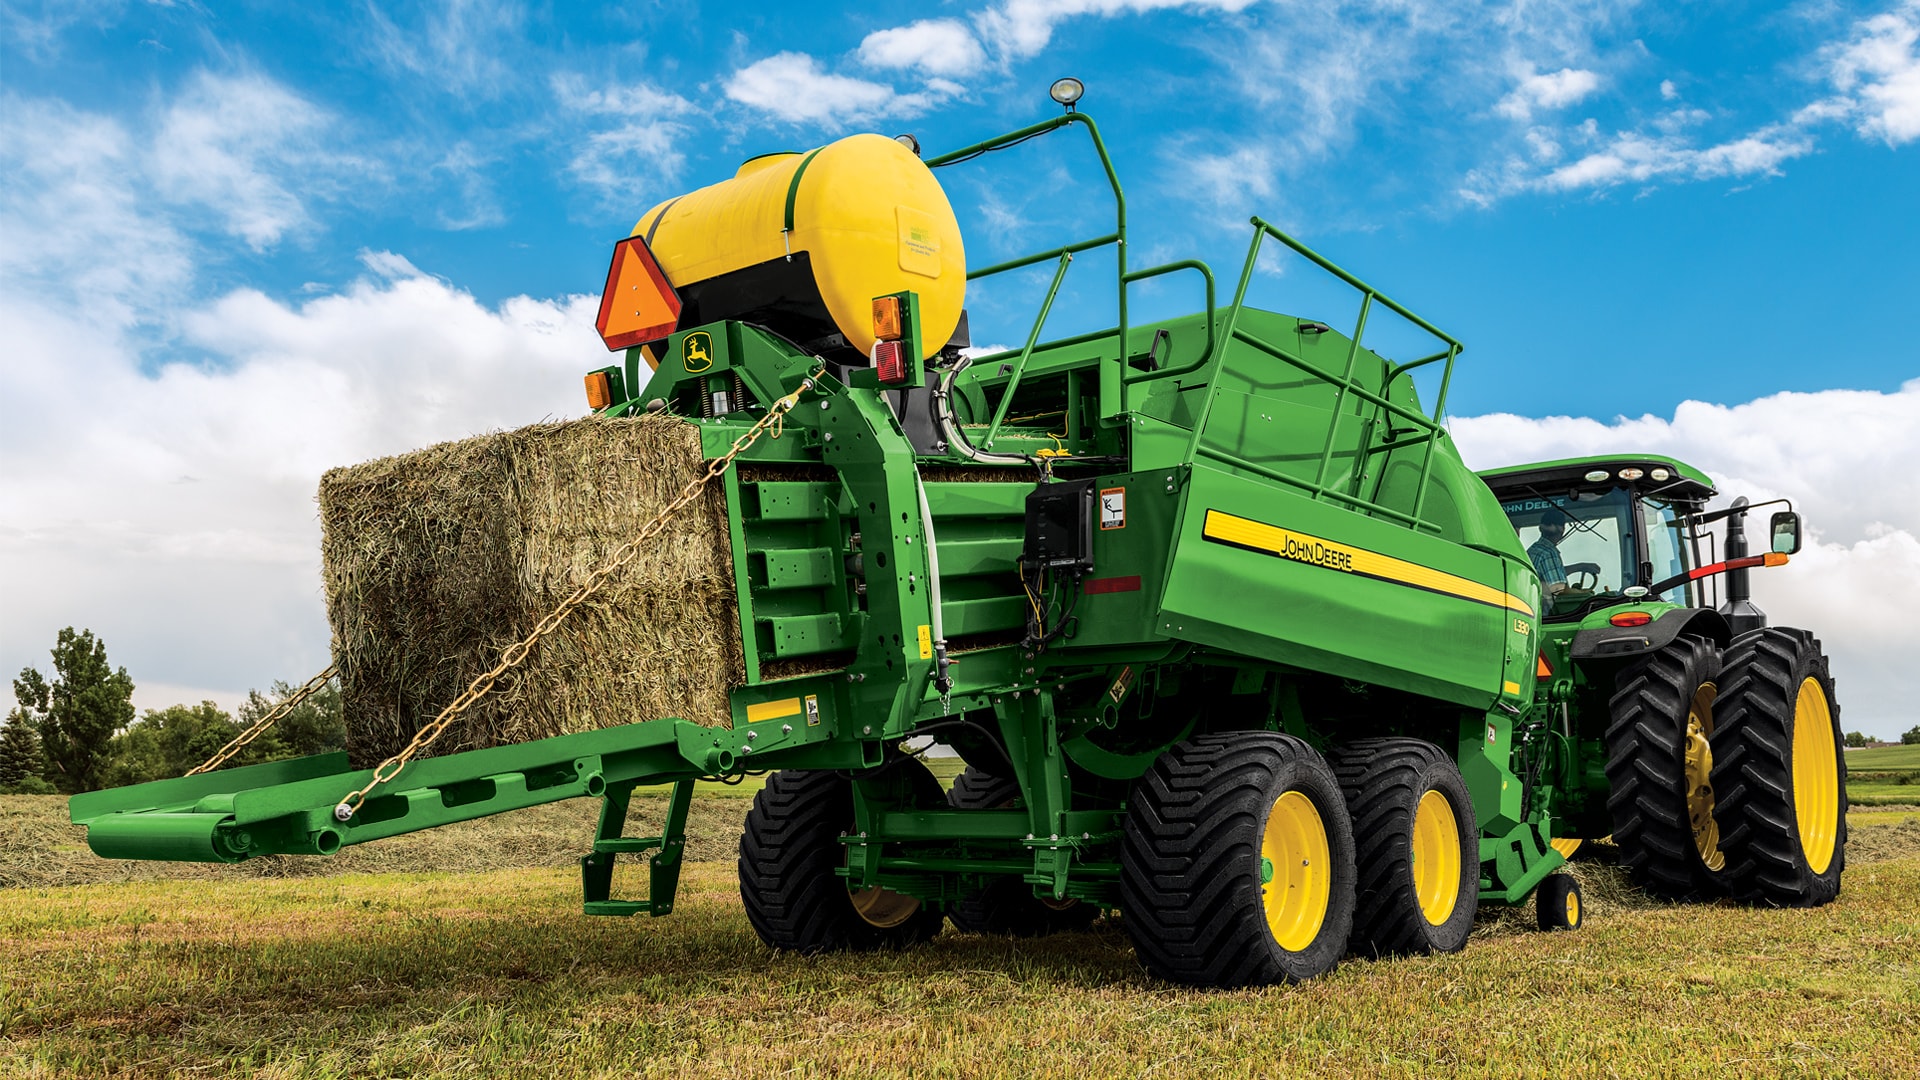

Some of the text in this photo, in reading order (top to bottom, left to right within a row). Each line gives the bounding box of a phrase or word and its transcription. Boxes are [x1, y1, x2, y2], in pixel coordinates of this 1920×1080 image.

[1503, 504, 1523, 513] HN
[1281, 534, 1352, 569] JOHN DEERE
[1513, 618, 1530, 636] L330
